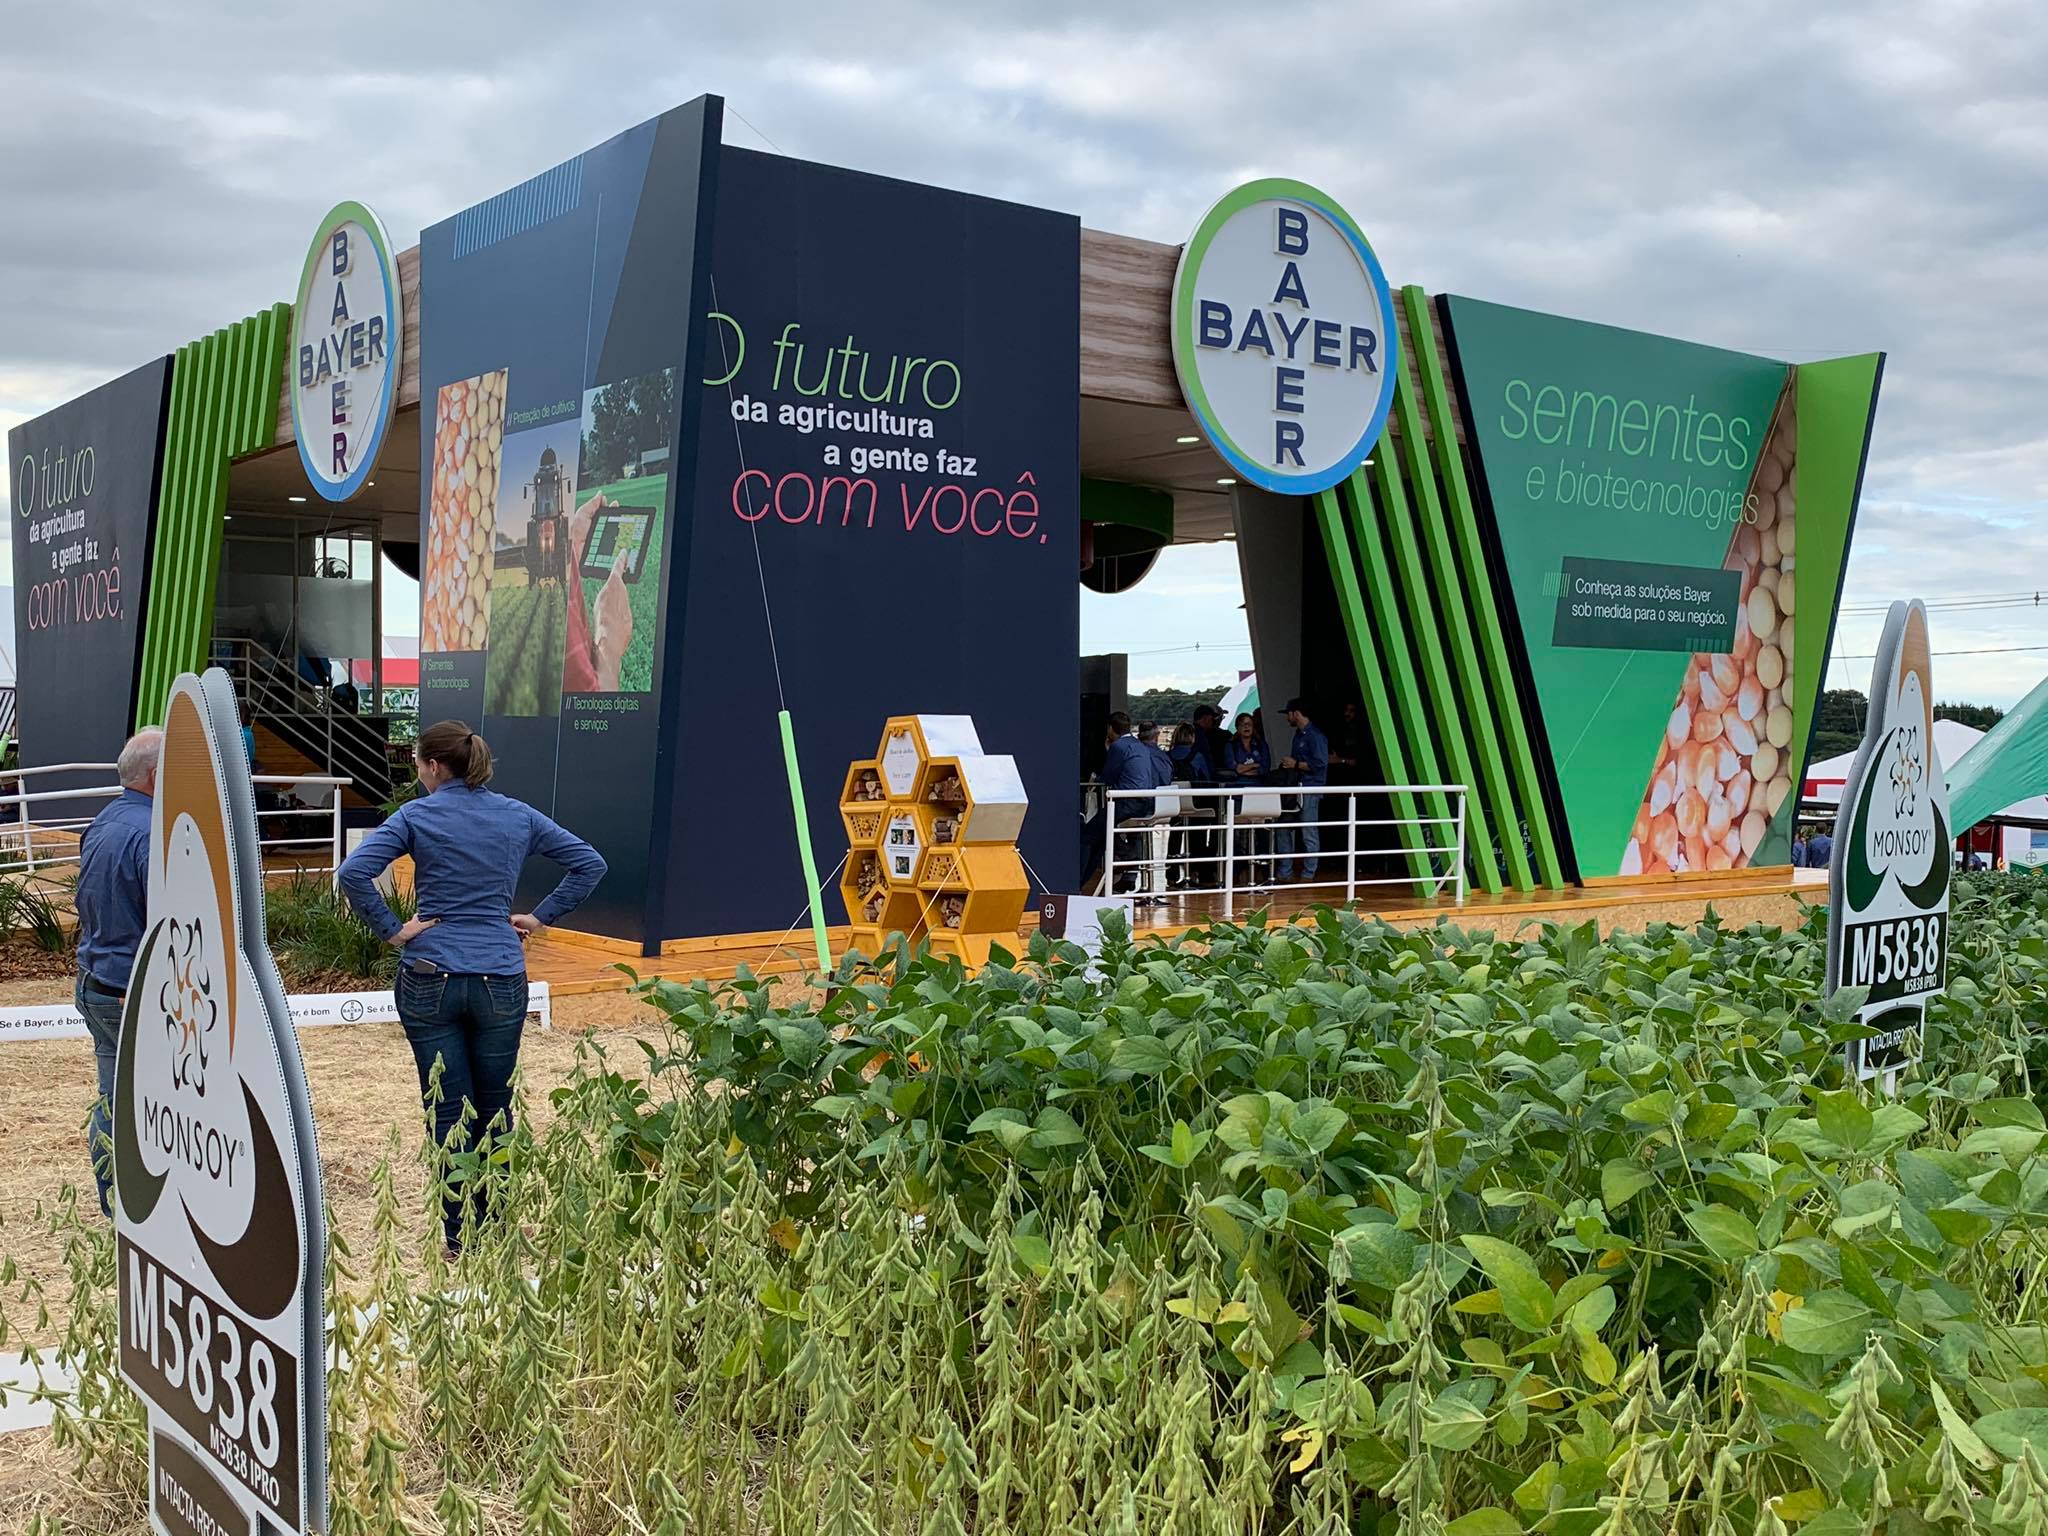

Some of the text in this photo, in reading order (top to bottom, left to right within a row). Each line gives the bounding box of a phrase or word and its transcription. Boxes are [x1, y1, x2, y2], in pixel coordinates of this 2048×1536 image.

[300, 315, 384, 387] BAYER
[331, 230, 350, 475] BAYER
[773, 322, 961, 410] futuro
[1200, 299, 1378, 373] BAYER
[1272, 207, 1310, 467] BAYER
[541, 403, 550, 418] de
[730, 394, 934, 439] da agricultura
[1500, 379, 1750, 471] sementes
[19, 445, 95, 518] O futuro
[823, 444, 978, 477] a gente faz
[29, 509, 85, 545] da agricultura
[732, 469, 1048, 544] com você.
[1526, 458, 1760, 531] e biotecnologias
[51, 537, 99, 574] a gente faz
[28, 547, 124, 631] com você.
[1571, 602, 1728, 627] sob medida para o seu negócio.
[1575, 578, 1711, 605] Conheça as soluções Bayer
[573, 696, 613, 713] Tecnologias
[613, 697, 640, 714] digitais
[574, 718, 609, 734] e serviços
[1851, 916, 1939, 987] M5838
[311, 1008, 331, 1016] bom
[367, 1005, 378, 1014] Se
[1904, 976, 1924, 994] M5838
[0, 1020, 12, 1029] Se
[15, 1020, 21, 1028] é
[24, 1019, 55, 1028] Bayer,
[58, 1018, 63, 1026] é
[129, 1247, 280, 1470] M5838
[160, 1465, 196, 1530] INTACTA
[210, 1423, 280, 1507] M5838 IPRO
